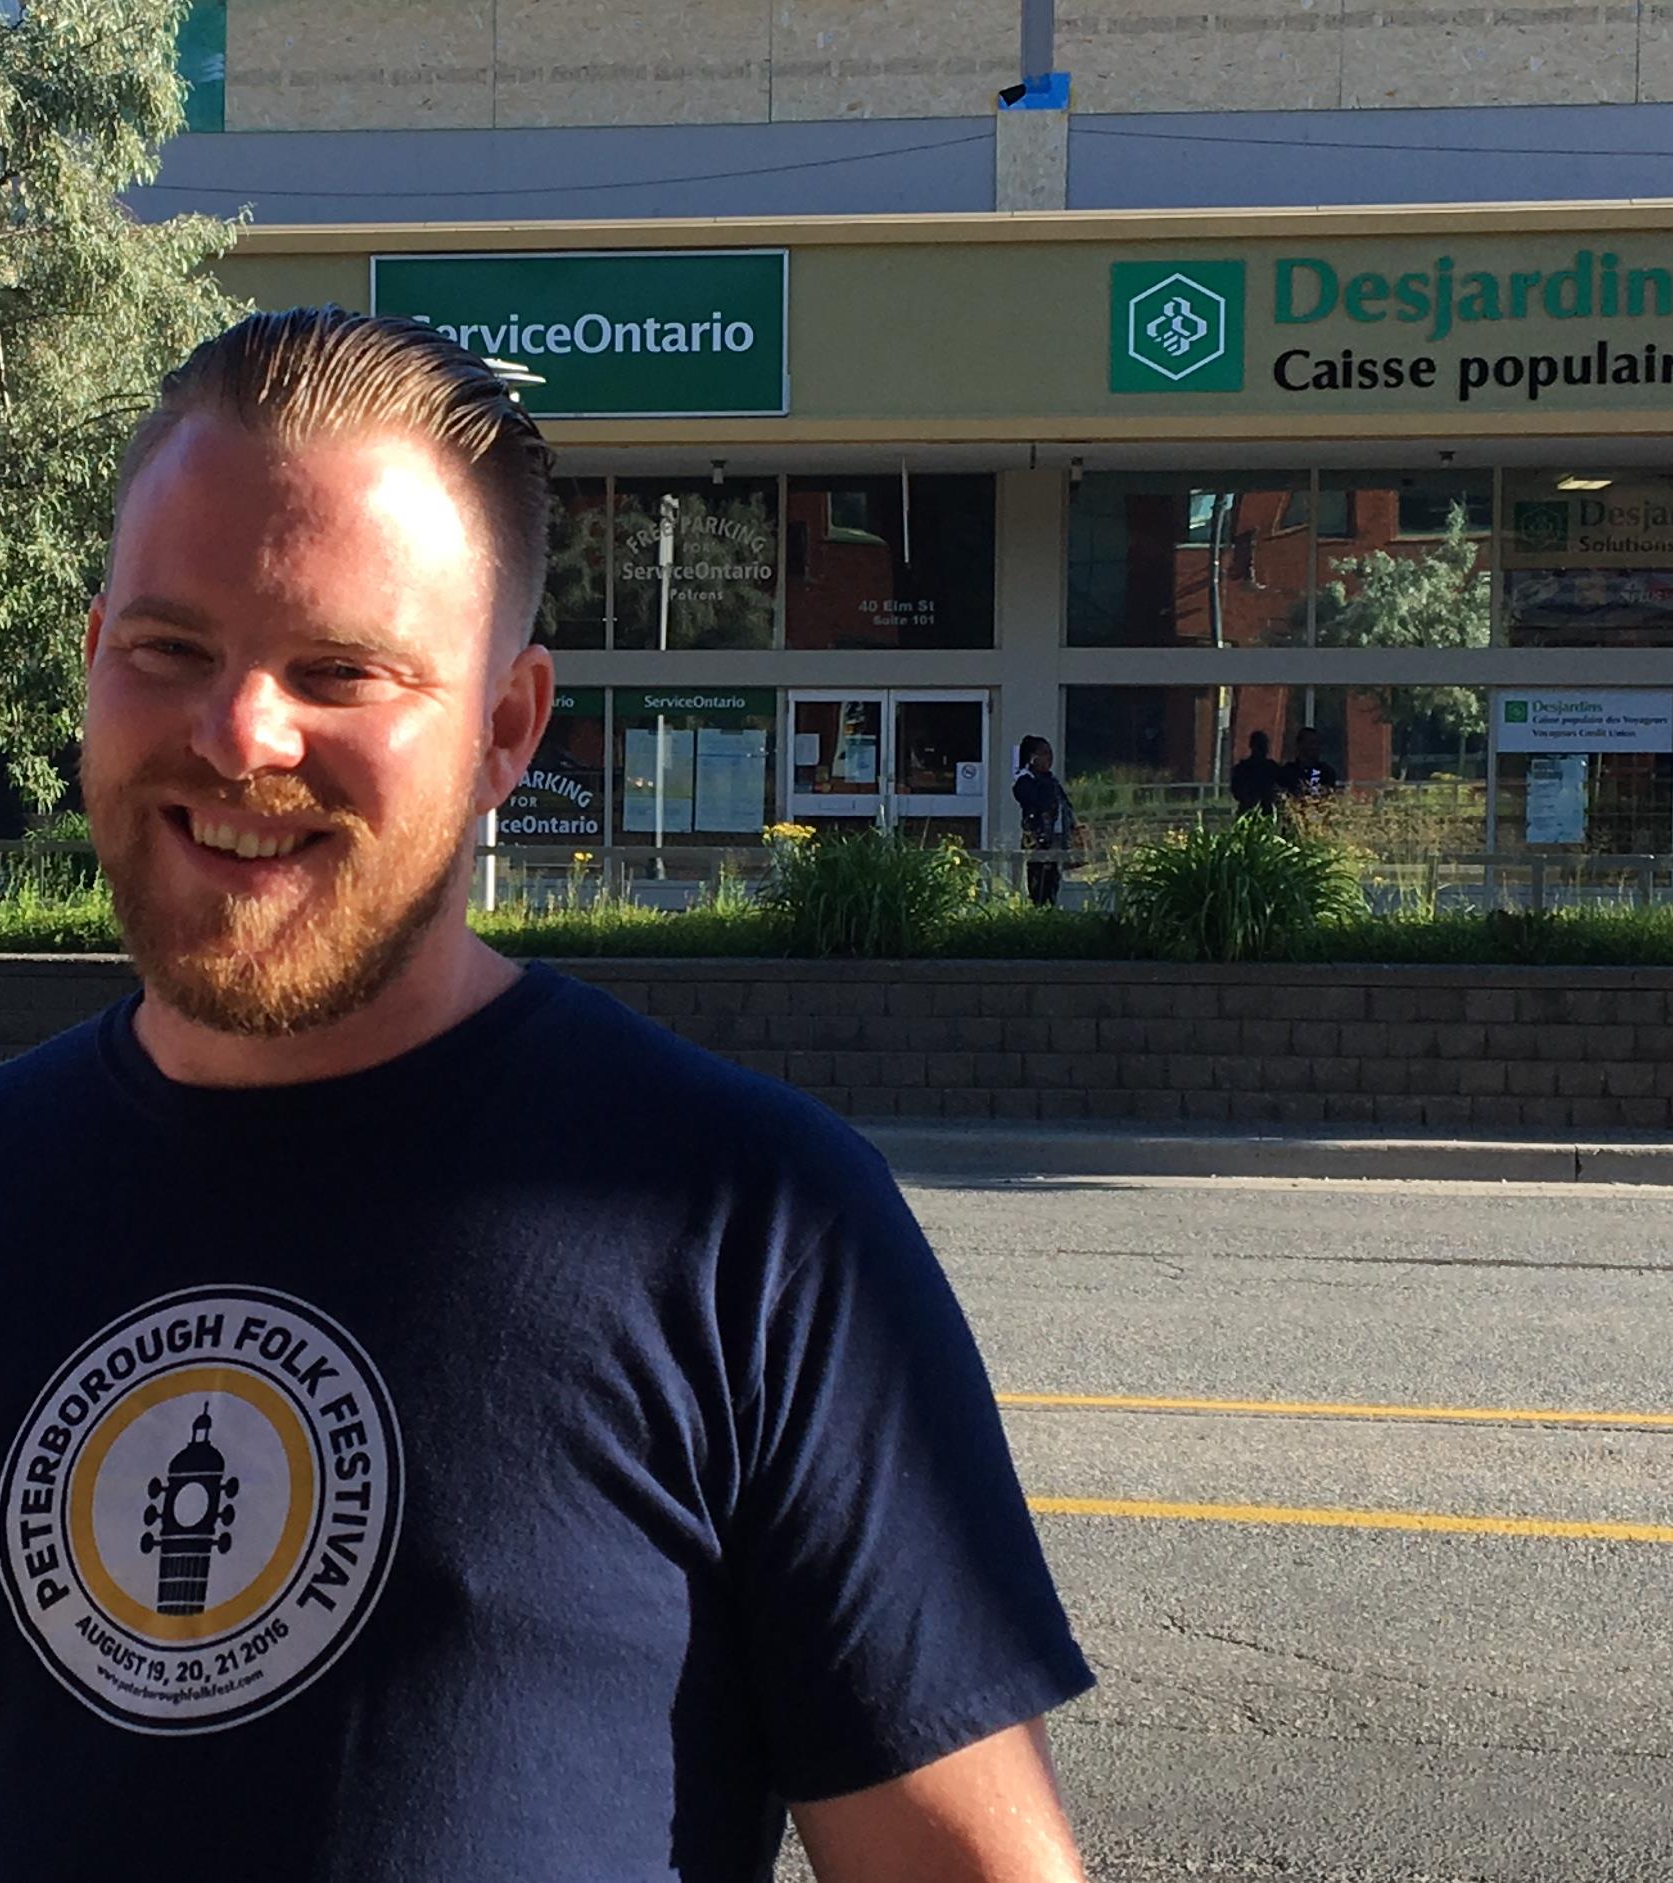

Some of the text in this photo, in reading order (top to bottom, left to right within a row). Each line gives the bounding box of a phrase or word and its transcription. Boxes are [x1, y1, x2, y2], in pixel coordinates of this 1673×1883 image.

[411, 311, 755, 354] erviceOntario
[1273, 349, 1437, 391] Caisse
[679, 512, 768, 553] PARKING
[621, 561, 772, 581] ServceOntario
[858, 601, 935, 612] 40 Elm St
[873, 615, 935, 625] Suite 101
[644, 695, 745, 709] ServiceOntario
[1532, 700, 1604, 715] Desjardins
[509, 796, 538, 808] FOR
[514, 769, 594, 809] ARKING
[494, 815, 599, 835] ceOntario
[20, 1313, 372, 1613] PETERBOROUGH FOLK FESTIVAL
[75, 1615, 290, 1686] AUGUST 19, 20, 21 2016
[96, 1664, 265, 1705] www.peterboroughfolkfest.com
